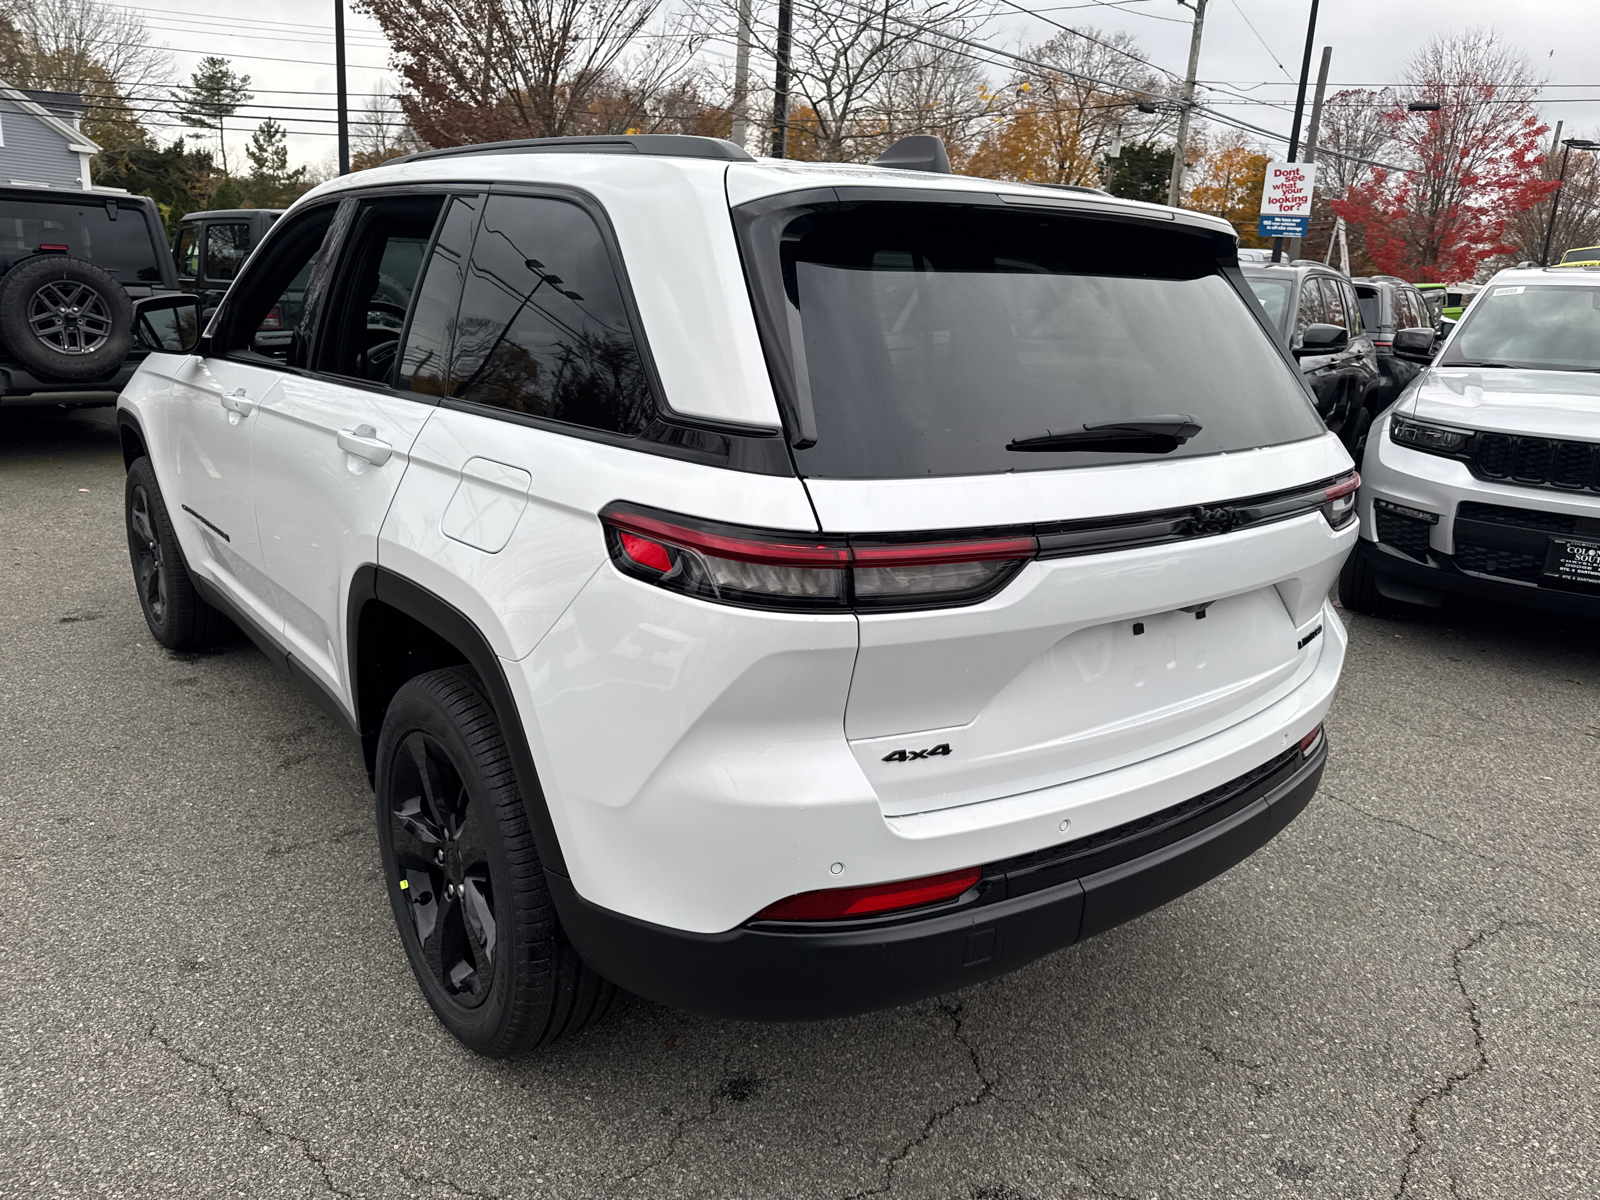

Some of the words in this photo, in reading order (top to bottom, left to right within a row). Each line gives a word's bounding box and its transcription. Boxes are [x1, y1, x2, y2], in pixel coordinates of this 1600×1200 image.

[1274, 168, 1300, 177] Dont
[1272, 182, 1297, 190] what
[1282, 188, 1303, 196] your
[1268, 195, 1308, 204] looking
[1279, 203, 1302, 212] for?
[1560, 559, 1600, 567] CHRYSLE
[881, 743, 953, 762] 4x4
